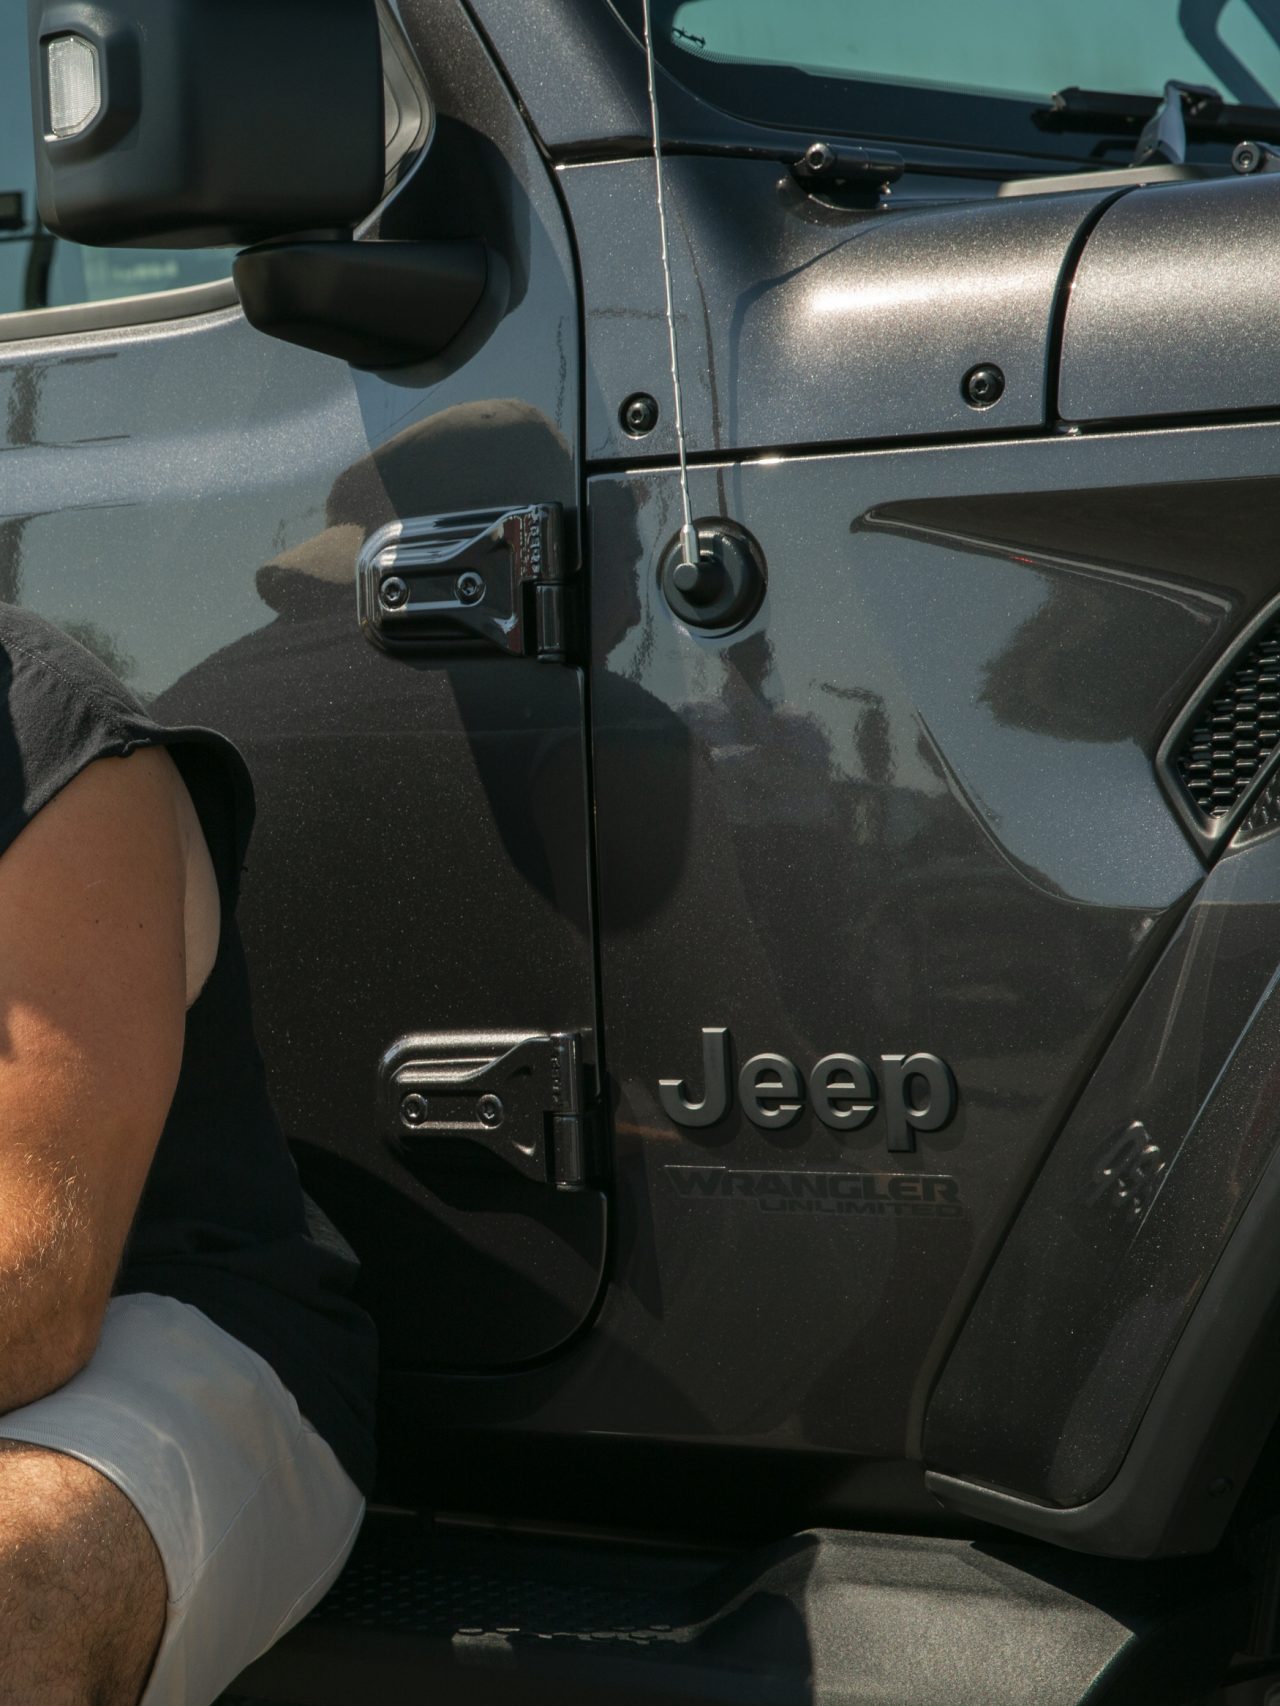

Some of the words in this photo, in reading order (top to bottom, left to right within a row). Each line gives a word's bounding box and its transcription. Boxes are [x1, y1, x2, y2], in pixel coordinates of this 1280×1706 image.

[659, 1027, 957, 1153] Jeep
[666, 1167, 959, 1201] WRANGLER
[760, 1199, 962, 1217] UNLIMITED
